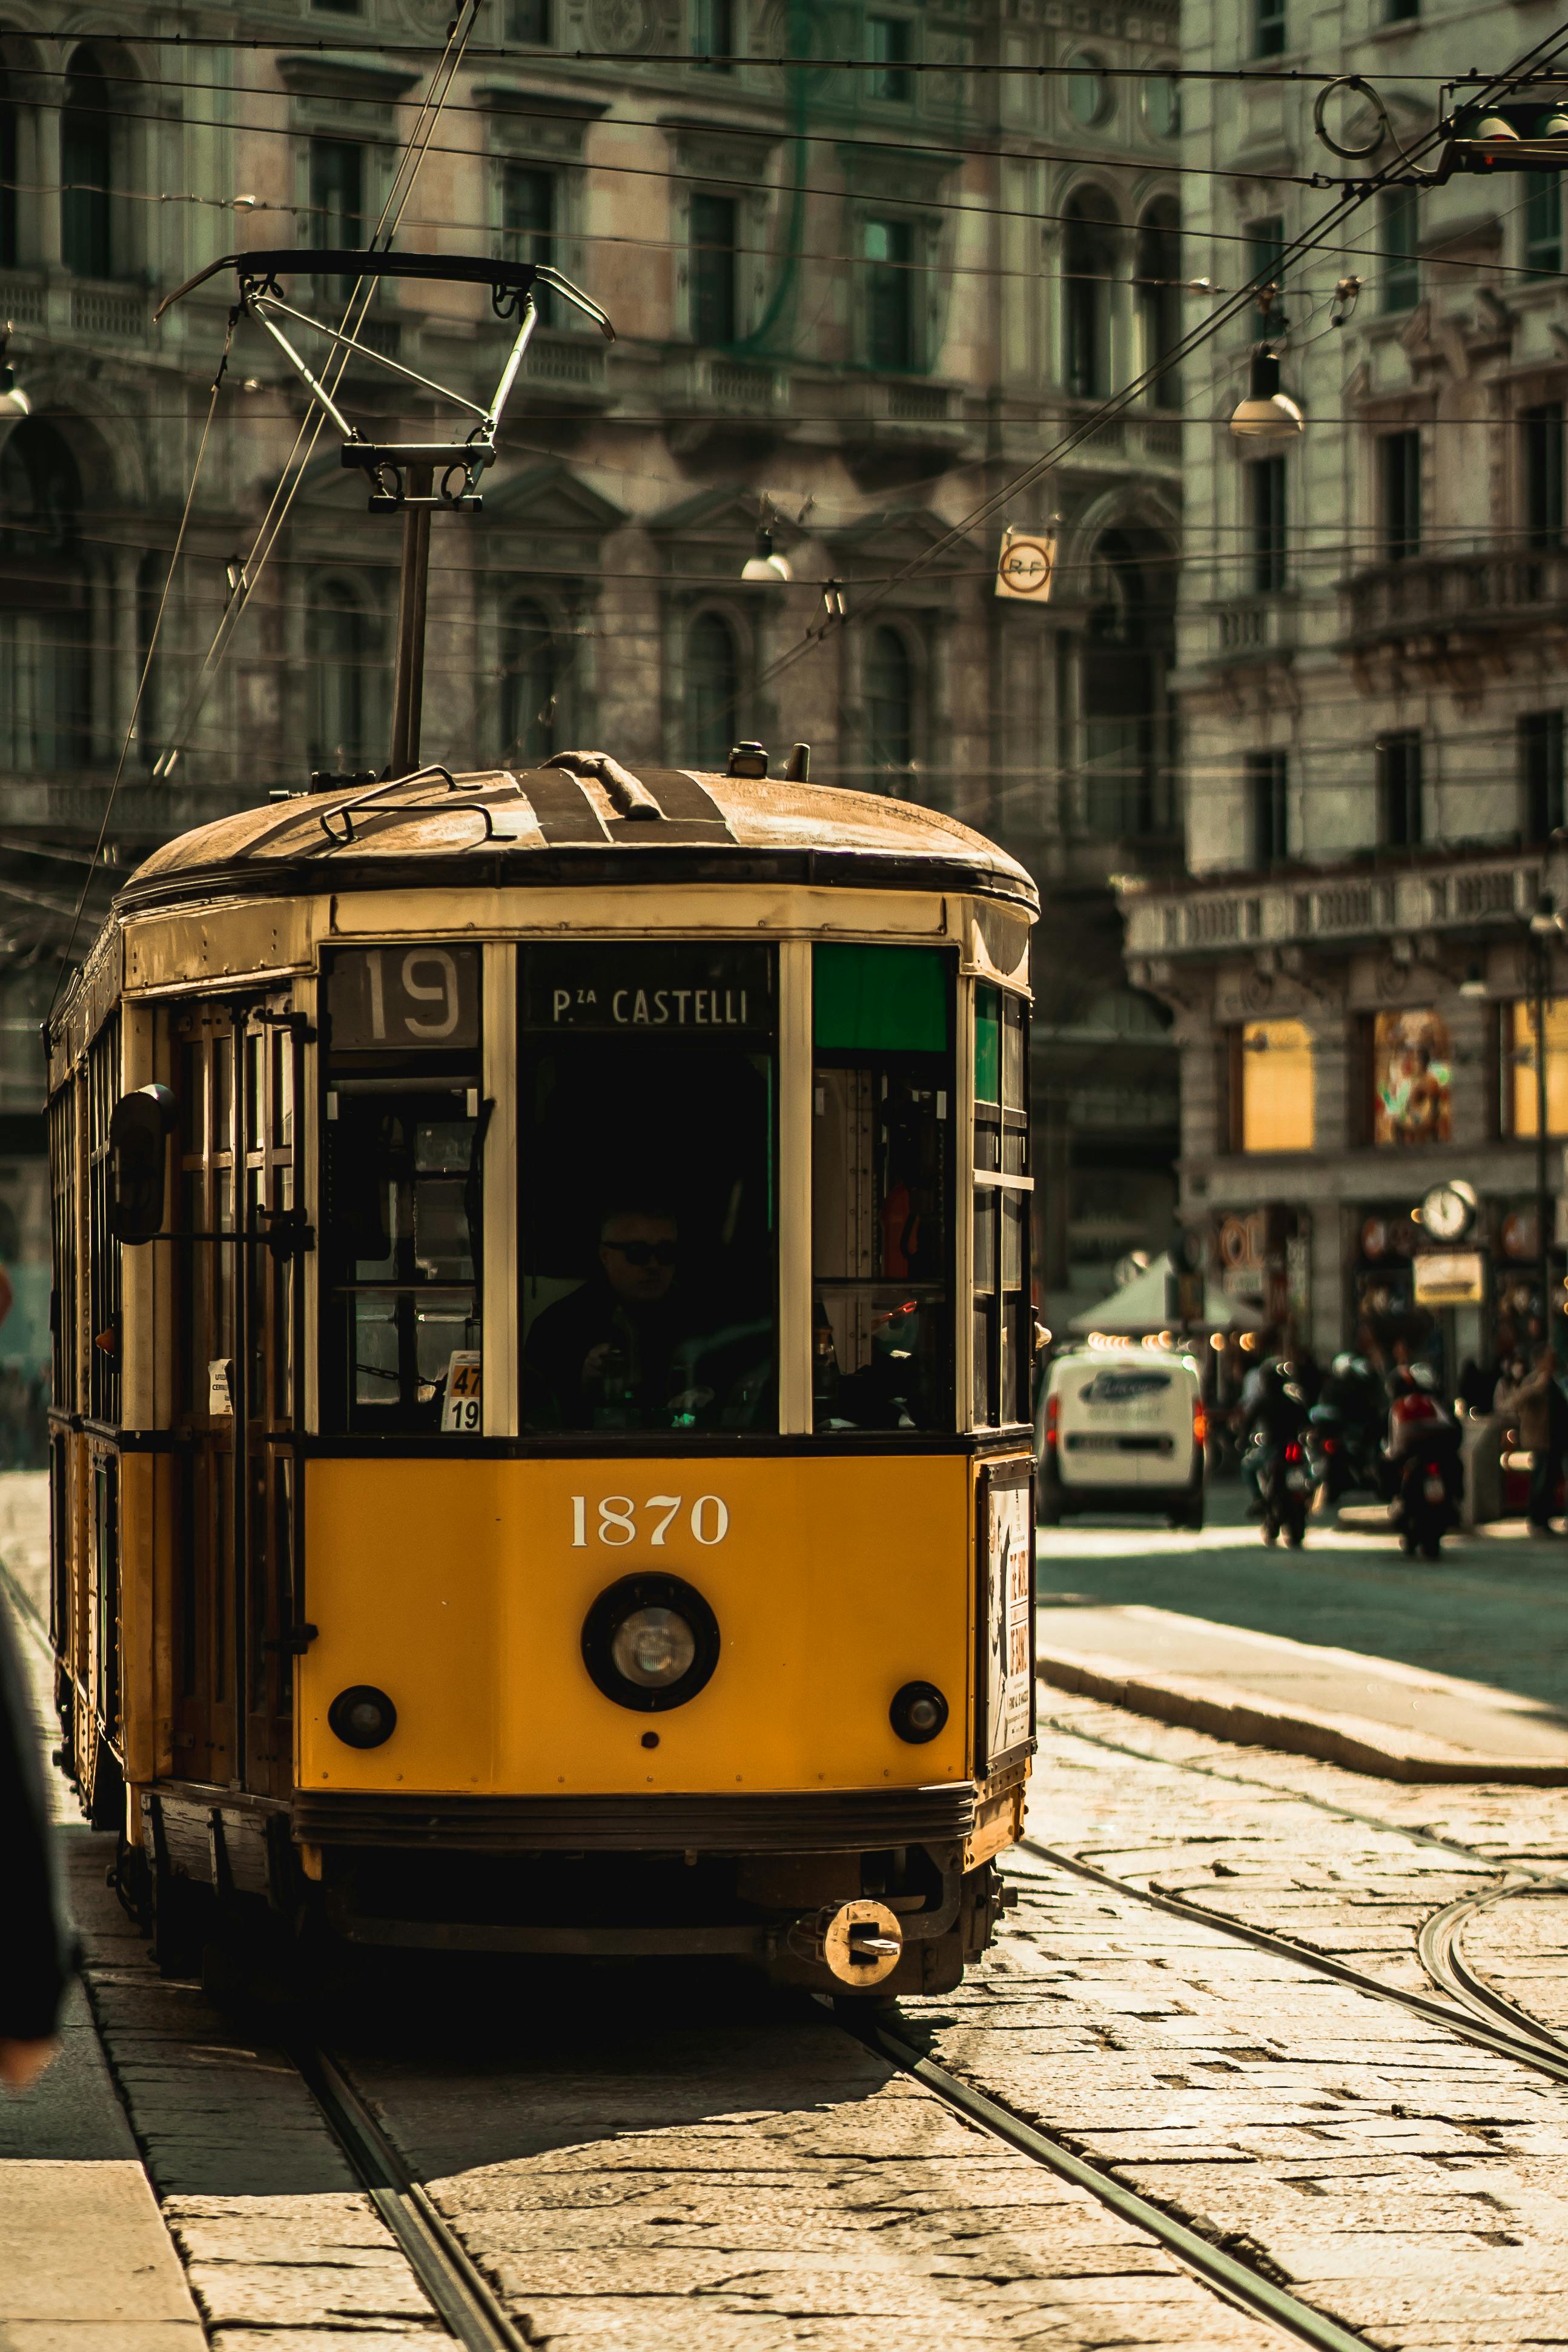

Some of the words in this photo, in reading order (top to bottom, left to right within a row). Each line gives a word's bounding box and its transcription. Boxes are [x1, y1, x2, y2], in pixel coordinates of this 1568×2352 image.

[366, 949, 458, 1039] 19
[612, 989, 746, 1024] CASTELLI
[454, 1368, 480, 1395] 47
[452, 1400, 478, 1429] 19
[571, 1495, 728, 1546] 1870
